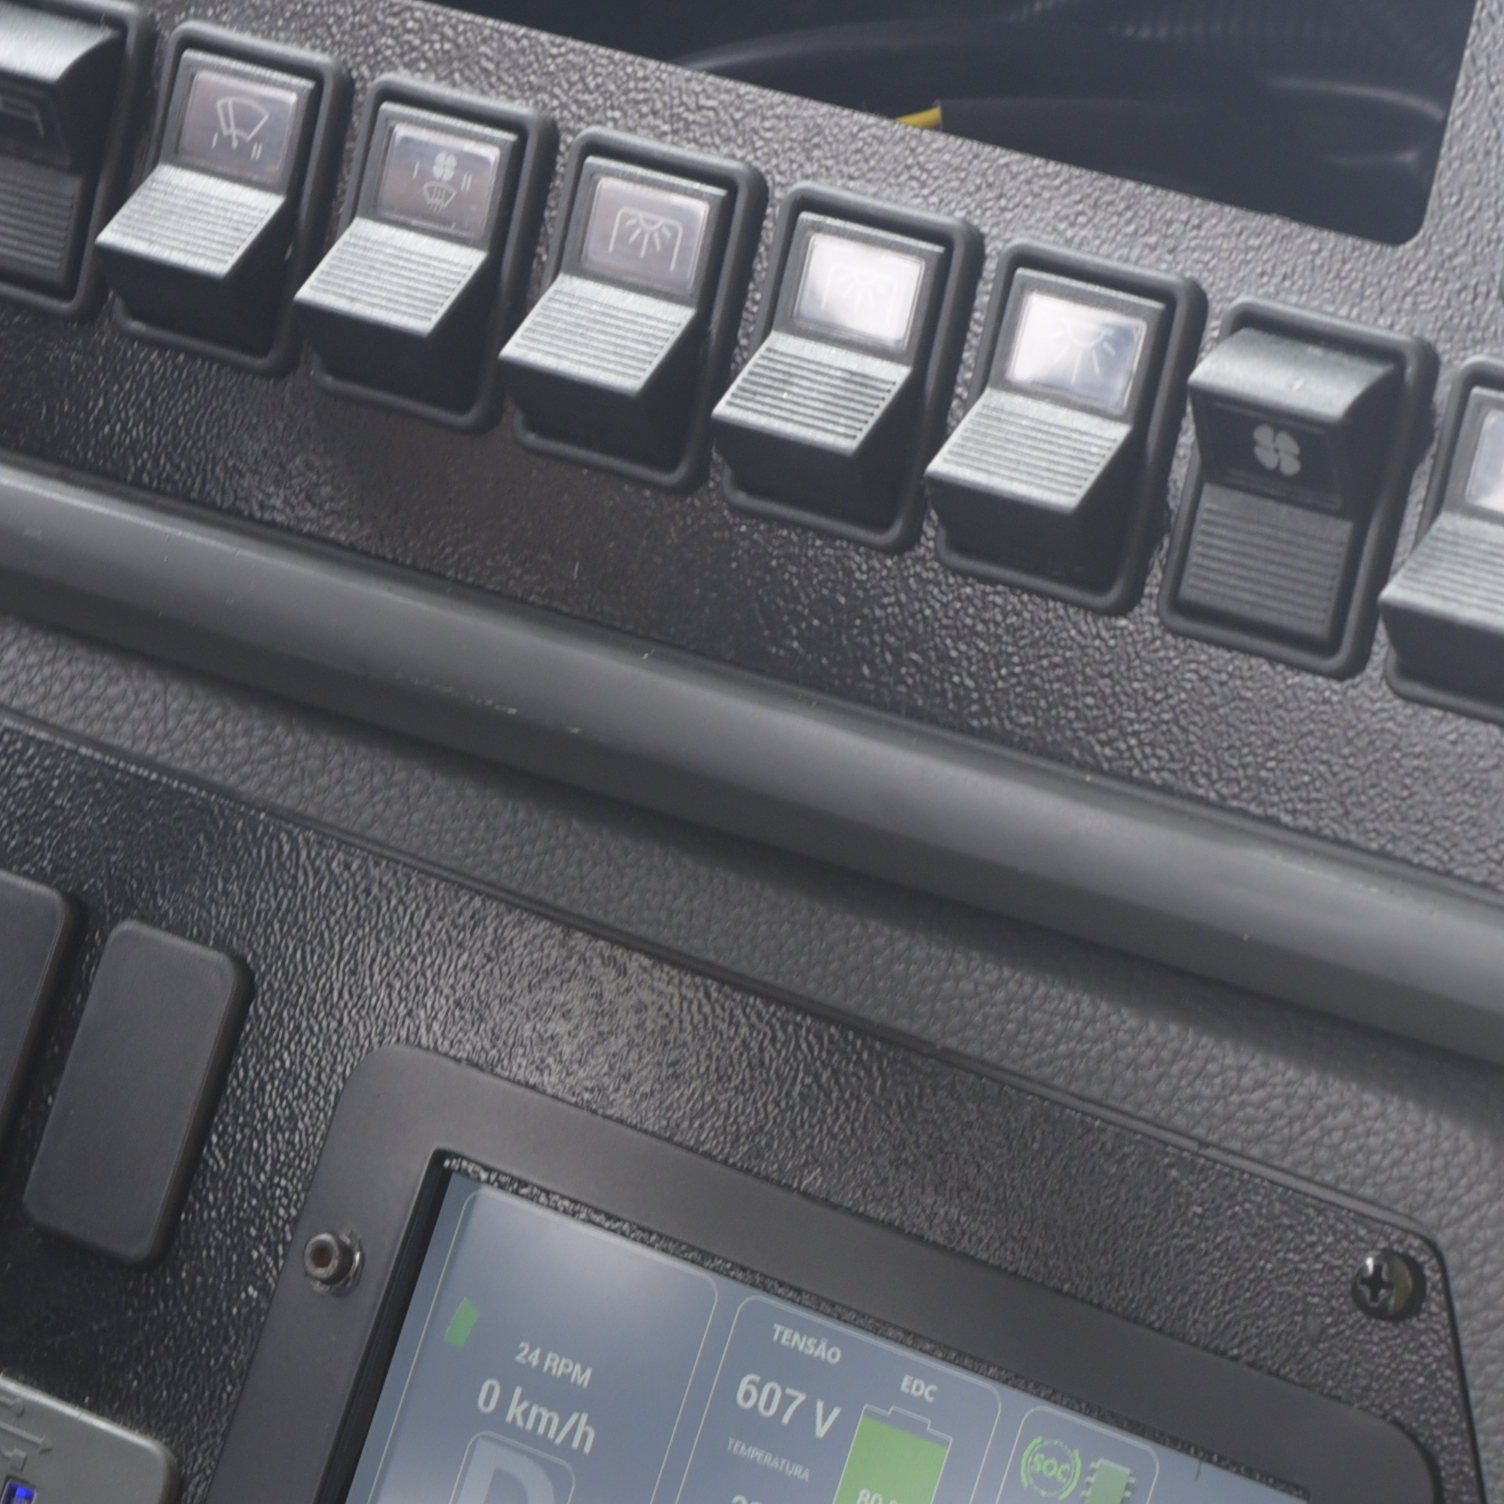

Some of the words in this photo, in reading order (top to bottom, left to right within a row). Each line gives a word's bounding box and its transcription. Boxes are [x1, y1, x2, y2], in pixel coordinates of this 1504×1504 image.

[514, 1340, 541, 1368] 24
[543, 1351, 593, 1389] RPM
[772, 1323, 841, 1364] TENSÃO
[736, 1373, 807, 1426] 607
[815, 1399, 842, 1439] V
[900, 1374, 938, 1403] EDC
[477, 1378, 500, 1413] 0
[505, 1385, 596, 1455] km/h
[727, 1437, 810, 1482] TEMPERATURA
[1030, 1452, 1071, 1483] SOC
